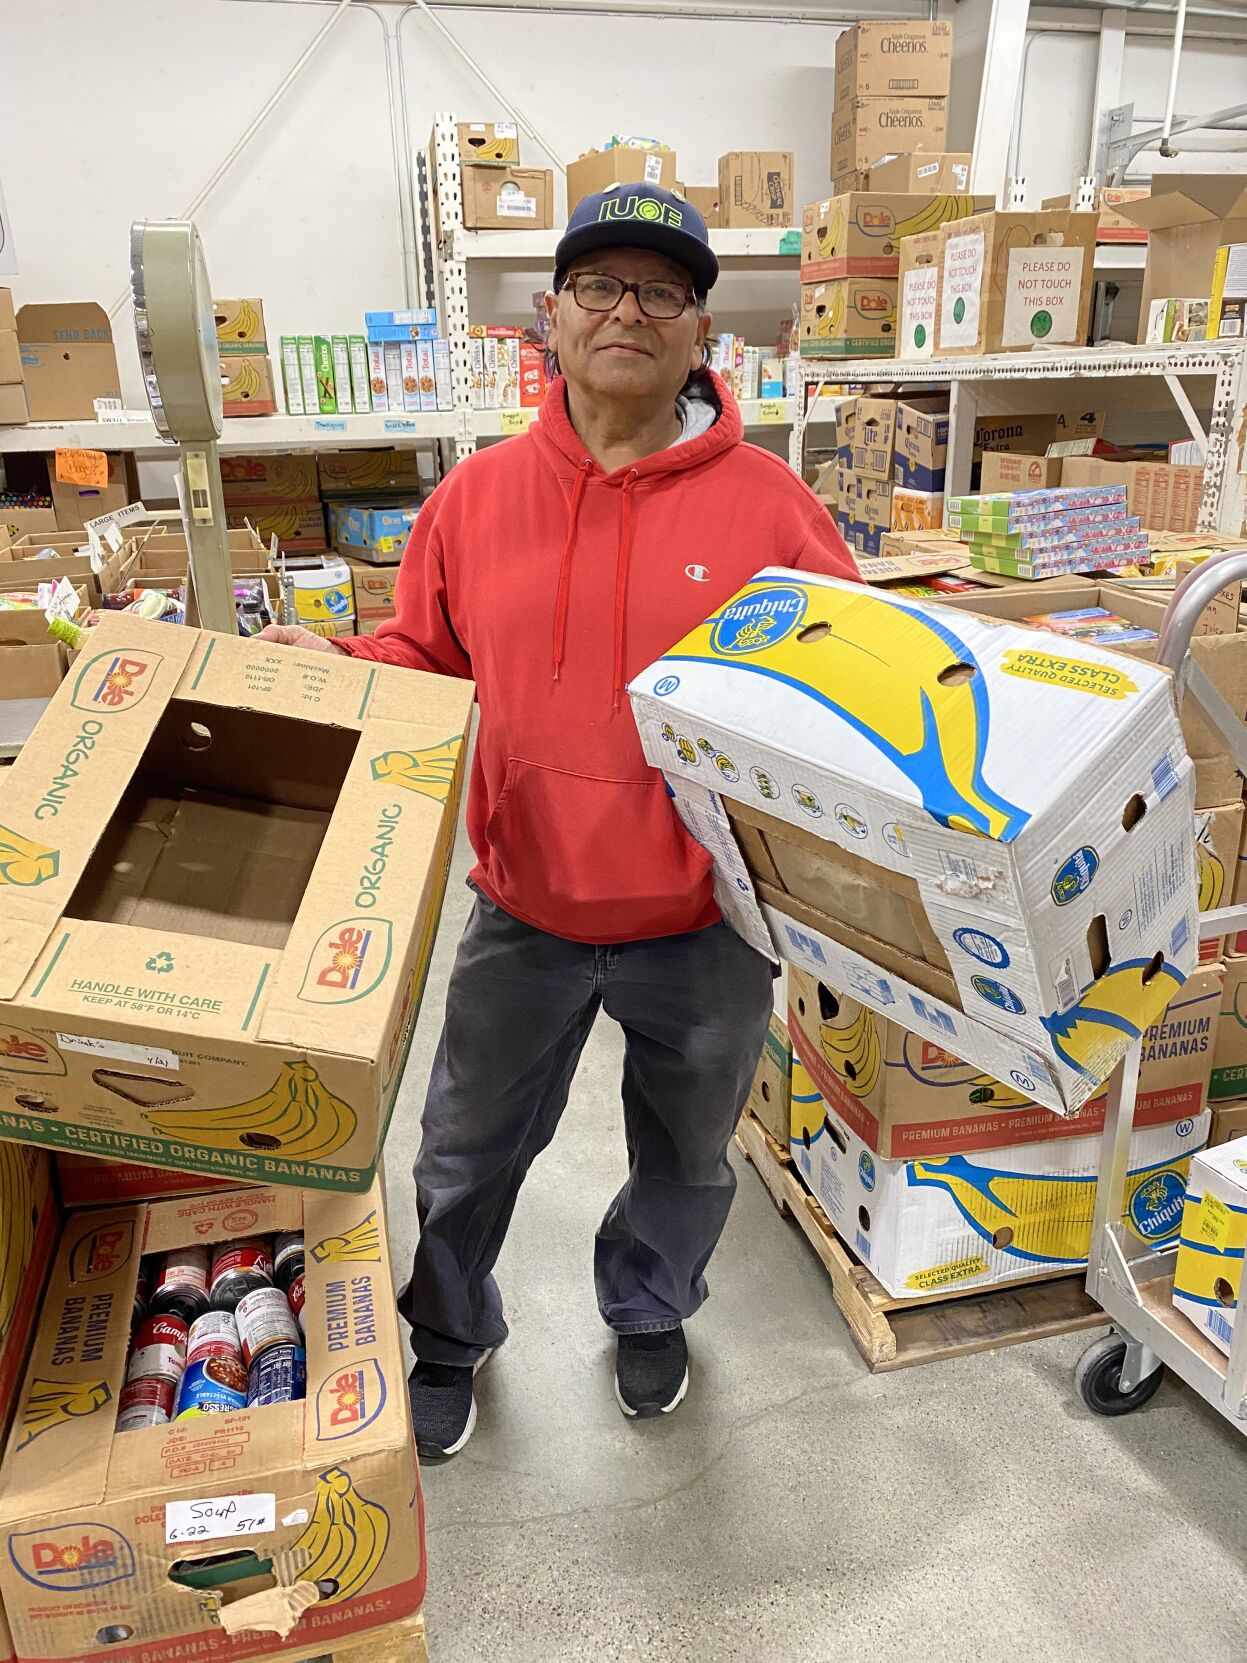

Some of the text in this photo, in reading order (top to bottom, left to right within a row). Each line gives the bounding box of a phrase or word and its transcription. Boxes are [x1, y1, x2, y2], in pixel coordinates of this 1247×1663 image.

[880, 38, 927, 54] Cheerios
[878, 112, 923, 128] Cheerios
[599, 196, 682, 228] IUOE
[863, 212, 891, 224] Dole
[951, 248, 976, 260] PLEASE DO
[949, 265, 976, 278] NOT TOUCH
[1022, 262, 1071, 272] PLEASE DO
[908, 280, 936, 290] PLEASE DO
[951, 283, 972, 294] THIS BOX
[1018, 280, 1072, 289] NOT TOUCH
[861, 294, 888, 308] Dole
[906, 298, 916, 306] NOT
[1024, 296, 1064, 306] THIS BOX
[910, 311, 932, 320] THIS BOX
[53, 328, 110, 340] SEND BACK
[864, 425, 878, 446] Lite
[904, 438, 920, 452] Corona
[974, 424, 1023, 447] Corona
[220, 458, 267, 478] Dole
[89, 504, 140, 529] LARGE ITEMS
[1219, 590, 1236, 602] xes
[720, 596, 806, 623] Chiquita
[1202, 624, 1224, 636] Juice
[1007, 662, 1119, 696] SELECTED QUALITY
[1016, 652, 1120, 684] CLASS EXTRA
[101, 658, 148, 706] Dole
[34, 720, 104, 820] ORGANIC
[354, 804, 402, 909] ORGANIC
[1072, 849, 1092, 891] Chiquita
[316, 927, 364, 989] Dole
[70, 979, 222, 1011] HANDLE WITH CARE
[82, 994, 112, 1007] KEEP
[114, 1000, 130, 1009] AT
[156, 1006, 174, 1016] OR
[197, 1054, 248, 1066] COMPANY,
[1140, 1036, 1208, 1062] BANANAS
[1154, 1091, 1194, 1108] BANANAS
[902, 1126, 950, 1141] PREMIUM
[952, 1122, 999, 1136] BANANAS
[1008, 1114, 1053, 1128] PREMIUM
[1054, 1108, 1100, 1122] BANAS
[0, 1115, 361, 1183] NAS CERTIFIED ORGANIC BANANAS
[178, 1206, 206, 1218] CARE
[208, 1201, 234, 1212] WITH
[234, 1196, 276, 1207] HANDLE
[1138, 1194, 1184, 1236] Chiquit
[93, 1230, 124, 1272] Dole
[914, 1257, 981, 1280] SELECTED QUALITY
[918, 1264, 981, 1288] CLASS EXTRA
[326, 1280, 350, 1352] PREMIUM
[351, 1275, 377, 1347] BANANAS
[52, 1296, 86, 1366] BANANAS
[80, 1293, 114, 1363] PREMIUM
[329, 1373, 360, 1426] Dole
[168, 1456, 192, 1466] DATE
[135, 1514, 160, 1525] DOLE
[32, 1536, 114, 1570] Dole
[142, 1638, 219, 1663] BANANAS
[312, 1600, 384, 1628] BANANAS
